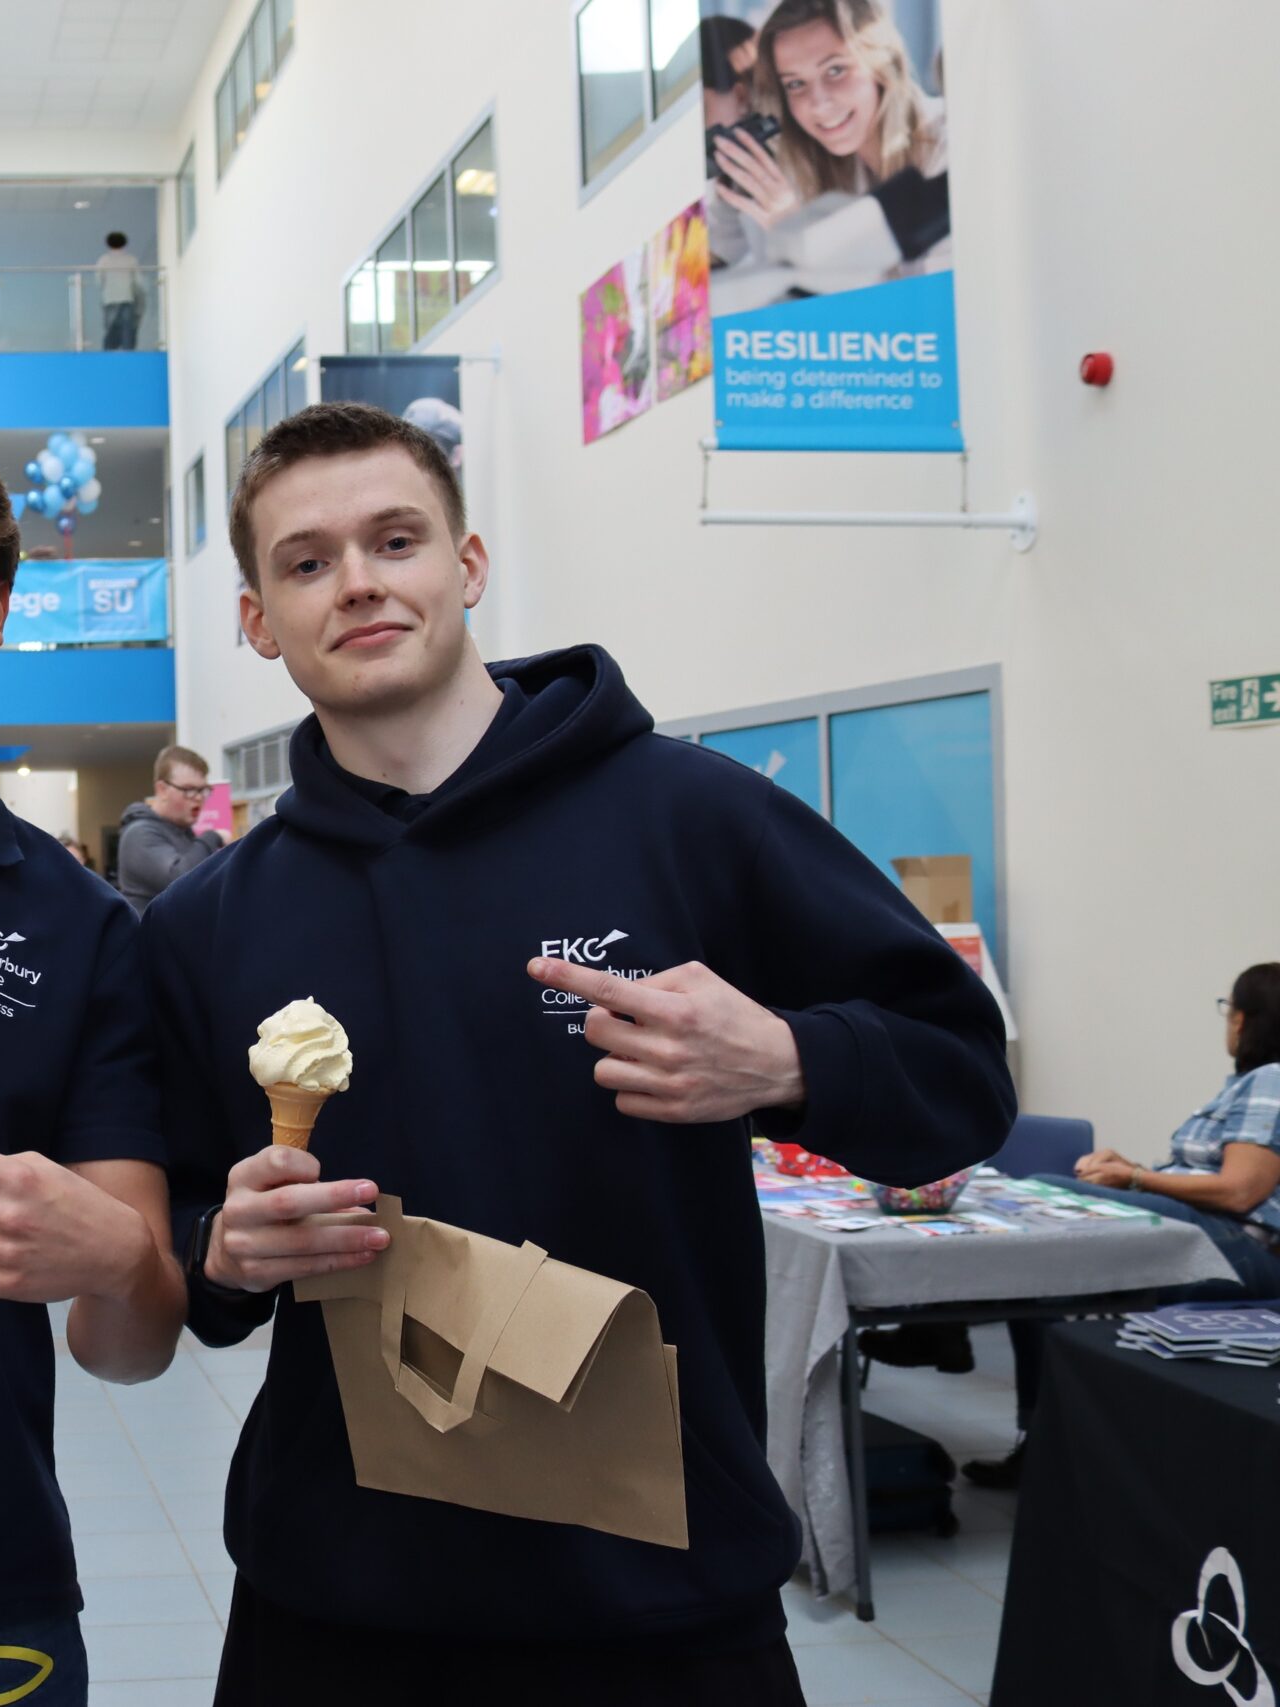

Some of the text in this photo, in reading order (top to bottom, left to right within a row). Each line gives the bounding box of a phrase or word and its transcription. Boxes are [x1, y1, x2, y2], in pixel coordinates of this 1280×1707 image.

[725, 330, 939, 362] RESILIENCE
[725, 367, 942, 390] being determined to
[726, 389, 913, 409] make a difference
[93, 589, 134, 614] SU
[1213, 683, 1237, 701] Fire
[1214, 703, 1237, 722] exit
